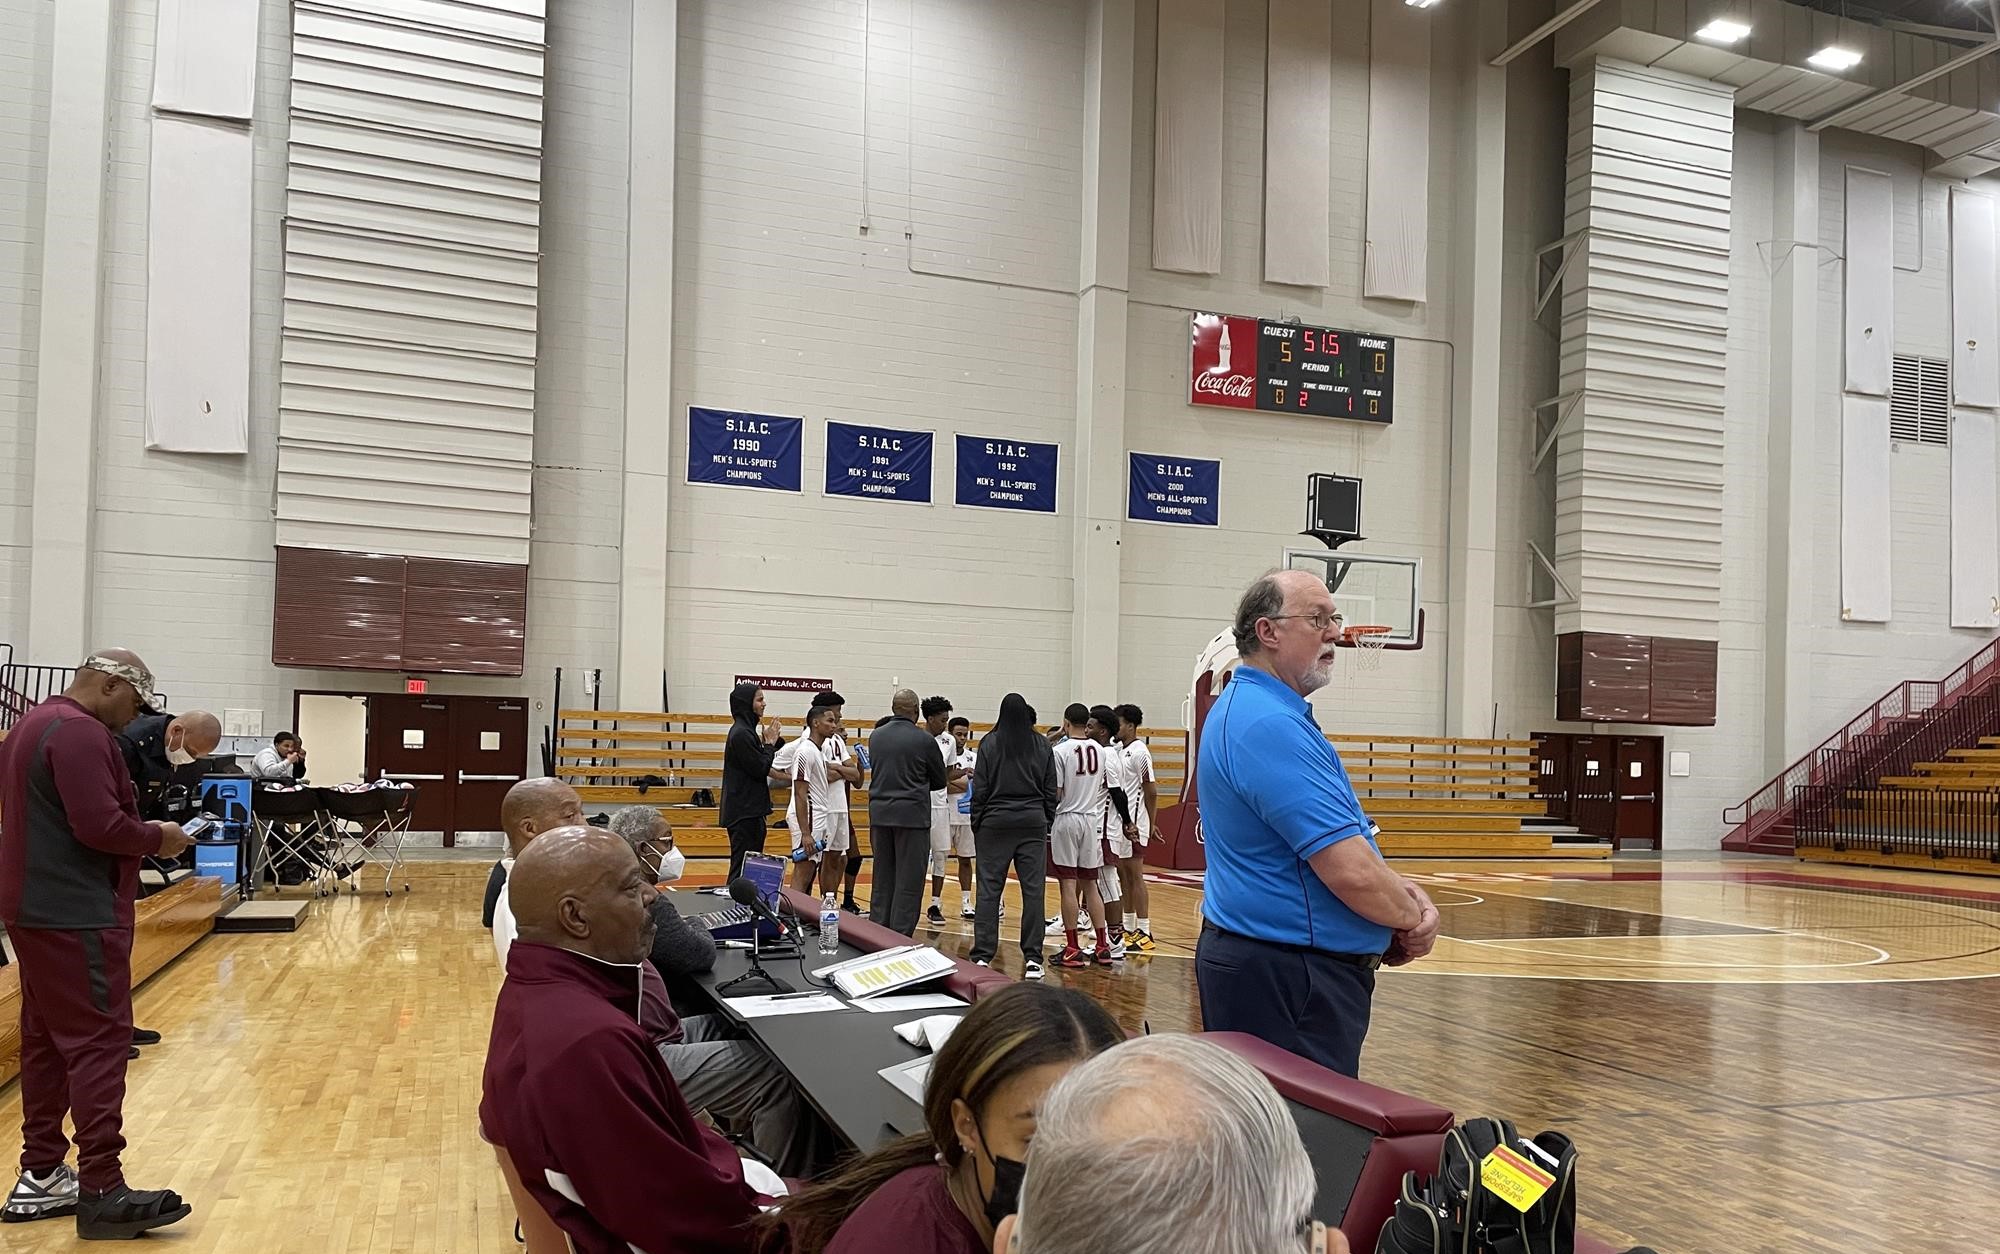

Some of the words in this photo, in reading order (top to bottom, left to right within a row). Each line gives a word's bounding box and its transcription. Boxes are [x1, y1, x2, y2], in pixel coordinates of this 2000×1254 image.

[1264, 326, 1295, 338] GUEST
[1360, 338, 1387, 349] HOME
[1281, 342, 1291, 362] 5
[1302, 362, 1329, 372] PERIOD
[1375, 353, 1384, 373] 0
[1276, 389, 1283, 404] 0
[1300, 392, 1308, 406] 2
[1370, 400, 1378, 414] 0
[726, 420, 770, 434] S.I.A.C.
[733, 438, 760, 452] 1990
[859, 436, 902, 451] S.I.A.C.
[986, 443, 1029, 458] S.I.A.C.
[713, 454, 732, 464] MEN'S
[736, 457, 776, 468] ALL-SPORTS
[872, 456, 889, 465] 1991
[998, 462, 1016, 471] 1992
[726, 470, 762, 480] CHAMPIONS
[848, 468, 866, 477] MEN'S
[872, 470, 910, 480] ALL-SPORTS
[1158, 464, 1194, 478] S.I.A.C.
[862, 484, 896, 494] CHAMPIONS
[976, 478, 994, 486] MEN'S
[1000, 480, 1036, 490] ALL-SPORTS
[1168, 483, 1184, 491] 2000
[990, 491, 1023, 502] CHAMPIONS
[1168, 494, 1208, 504] ALL-SPORTS
[1156, 506, 1192, 516] CHAMPIONS
[408, 680, 425, 692] EXIT
[770, 680, 799, 688] McAfee,
[830, 741, 841, 760] 14
[1074, 745, 1098, 775] 10
[1482, 1172, 1523, 1202] SAFESPORT
[1490, 1168, 1526, 1194] HELPLINE
